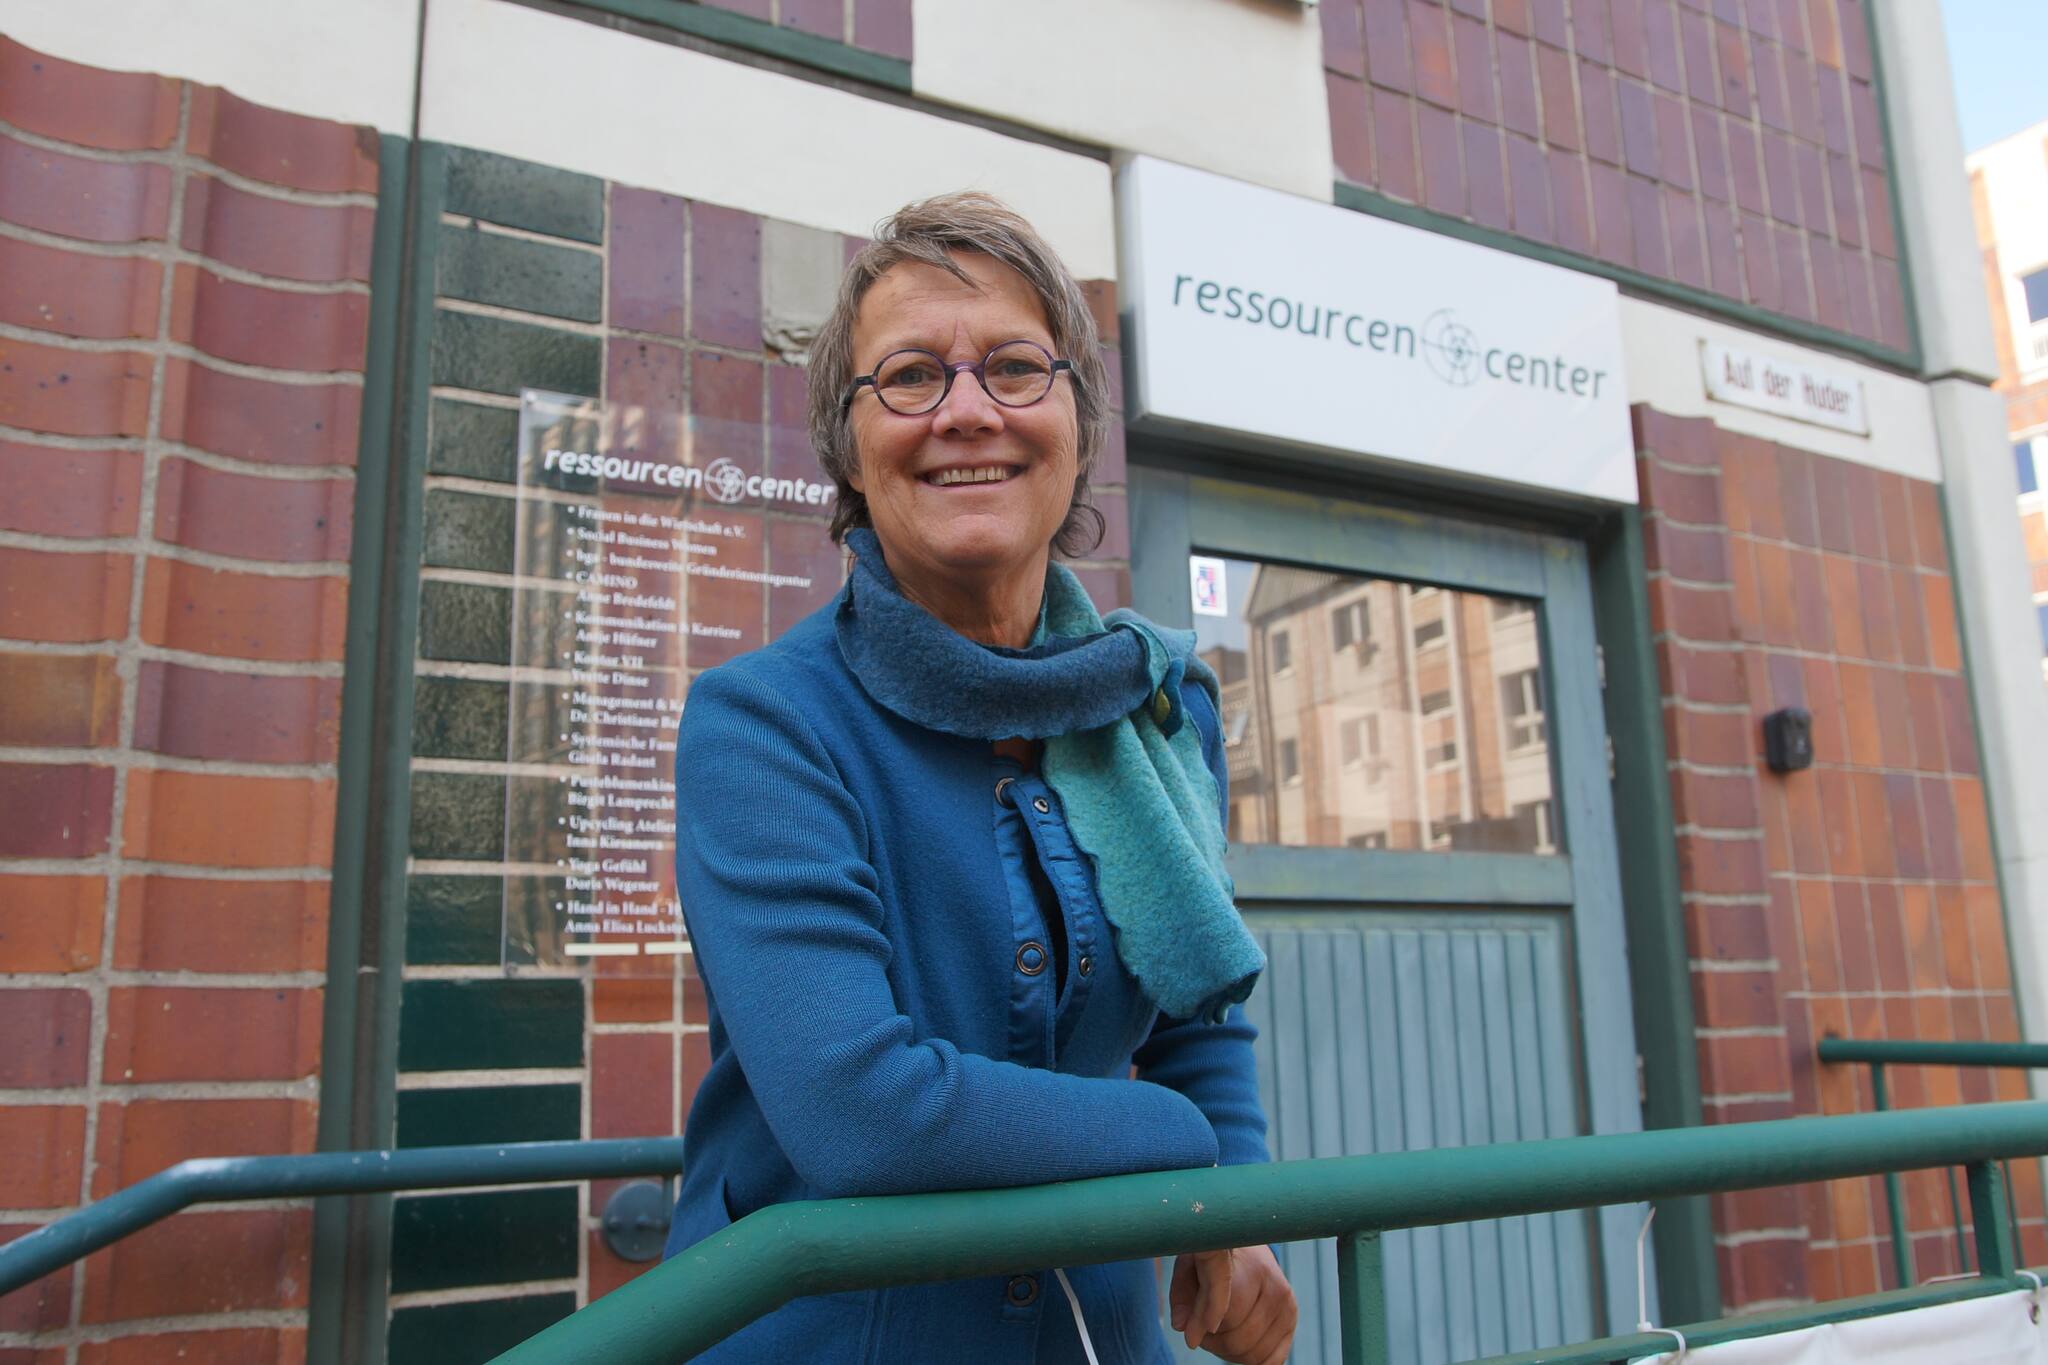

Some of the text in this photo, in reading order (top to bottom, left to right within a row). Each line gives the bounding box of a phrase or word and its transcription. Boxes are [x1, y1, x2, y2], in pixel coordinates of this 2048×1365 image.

[1171, 272, 1609, 400] ressourcen center
[1723, 353, 1754, 391] Auf
[543, 450, 838, 505] ressourcen center
[578, 505, 622, 522] Frauen
[623, 511, 638, 524] in
[661, 516, 722, 535] Wirtschaft
[577, 527, 717, 555] Social Business Women
[609, 552, 685, 572] bundesweite
[576, 571, 638, 589] CAMINO
[576, 611, 677, 633] Kommunikation
[692, 622, 743, 639] Karriere
[573, 691, 654, 711] Management
[591, 710, 659, 728] Christiane
[571, 731, 646, 750] Systemische
[569, 815, 634, 835] Upcycling
[602, 858, 647, 874] Gefühl
[567, 901, 604, 914] Hand
[606, 901, 620, 914] in
[622, 901, 658, 915] Hand
